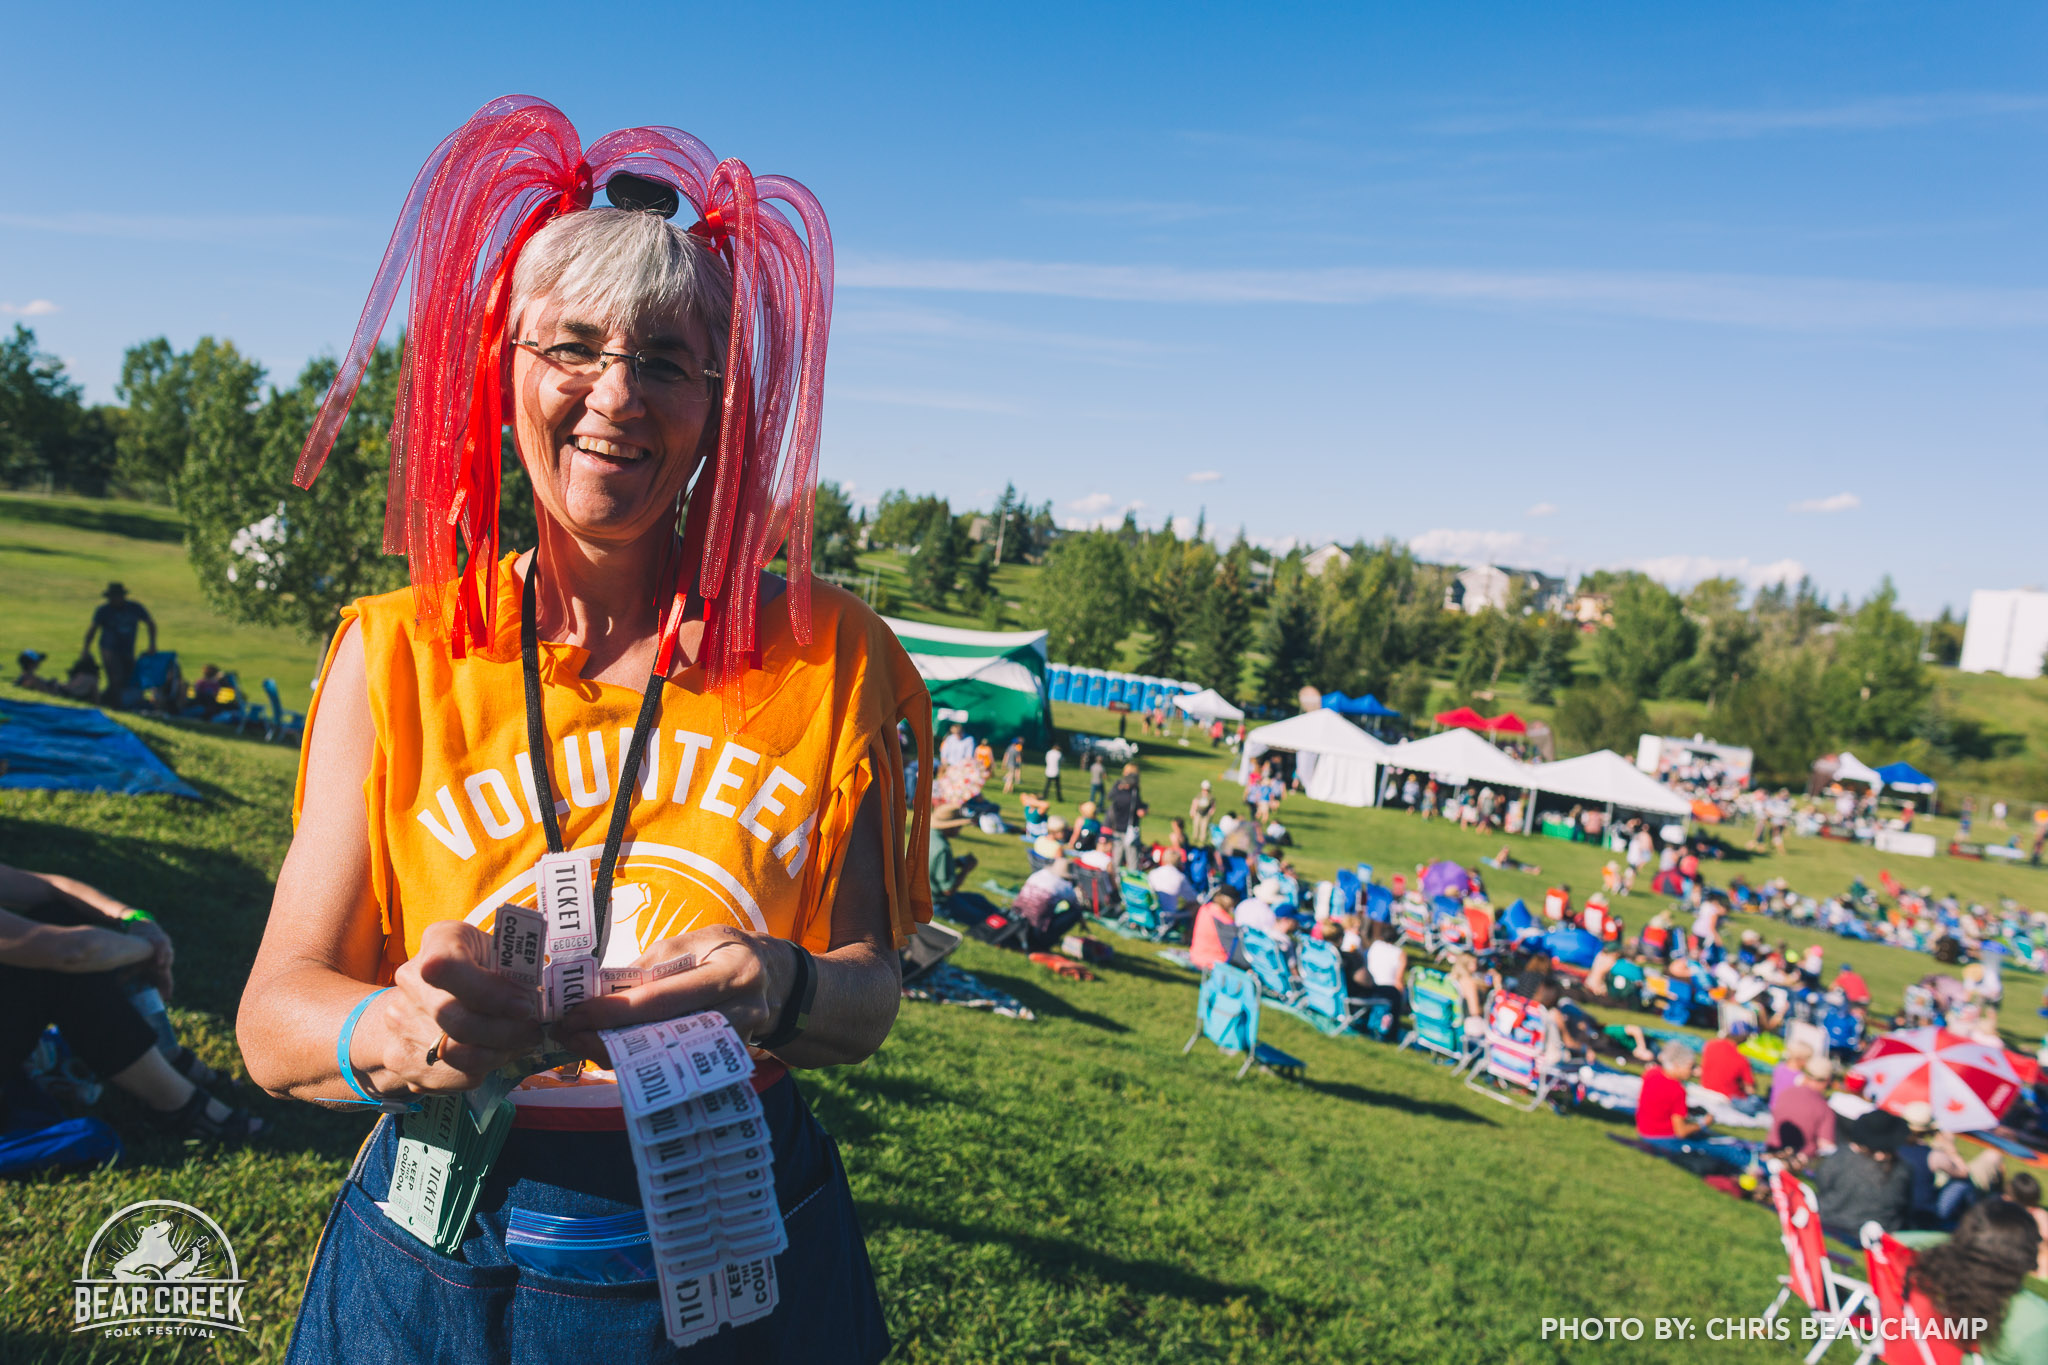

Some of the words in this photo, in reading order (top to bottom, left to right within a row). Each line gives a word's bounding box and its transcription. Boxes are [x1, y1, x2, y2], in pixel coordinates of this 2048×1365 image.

[416, 726, 819, 880] VOLUNTEER
[555, 864, 580, 930] TICKET
[501, 915, 518, 968] COUPON
[515, 936, 524, 955] THIS
[524, 931, 539, 965] KEEP
[562, 965, 585, 1015] TICK
[604, 971, 639, 981] 532040
[691, 1051, 713, 1075] KEEP
[714, 1036, 741, 1074] COUPON
[636, 1061, 672, 1105] TICKET
[396, 1145, 410, 1192] COUPON
[408, 1160, 418, 1191] KEEP
[423, 1165, 442, 1216] TICKET
[726, 1263, 743, 1299] KEE
[741, 1264, 751, 1286] THI
[751, 1259, 768, 1304] COU
[675, 1277, 704, 1328] TIC
